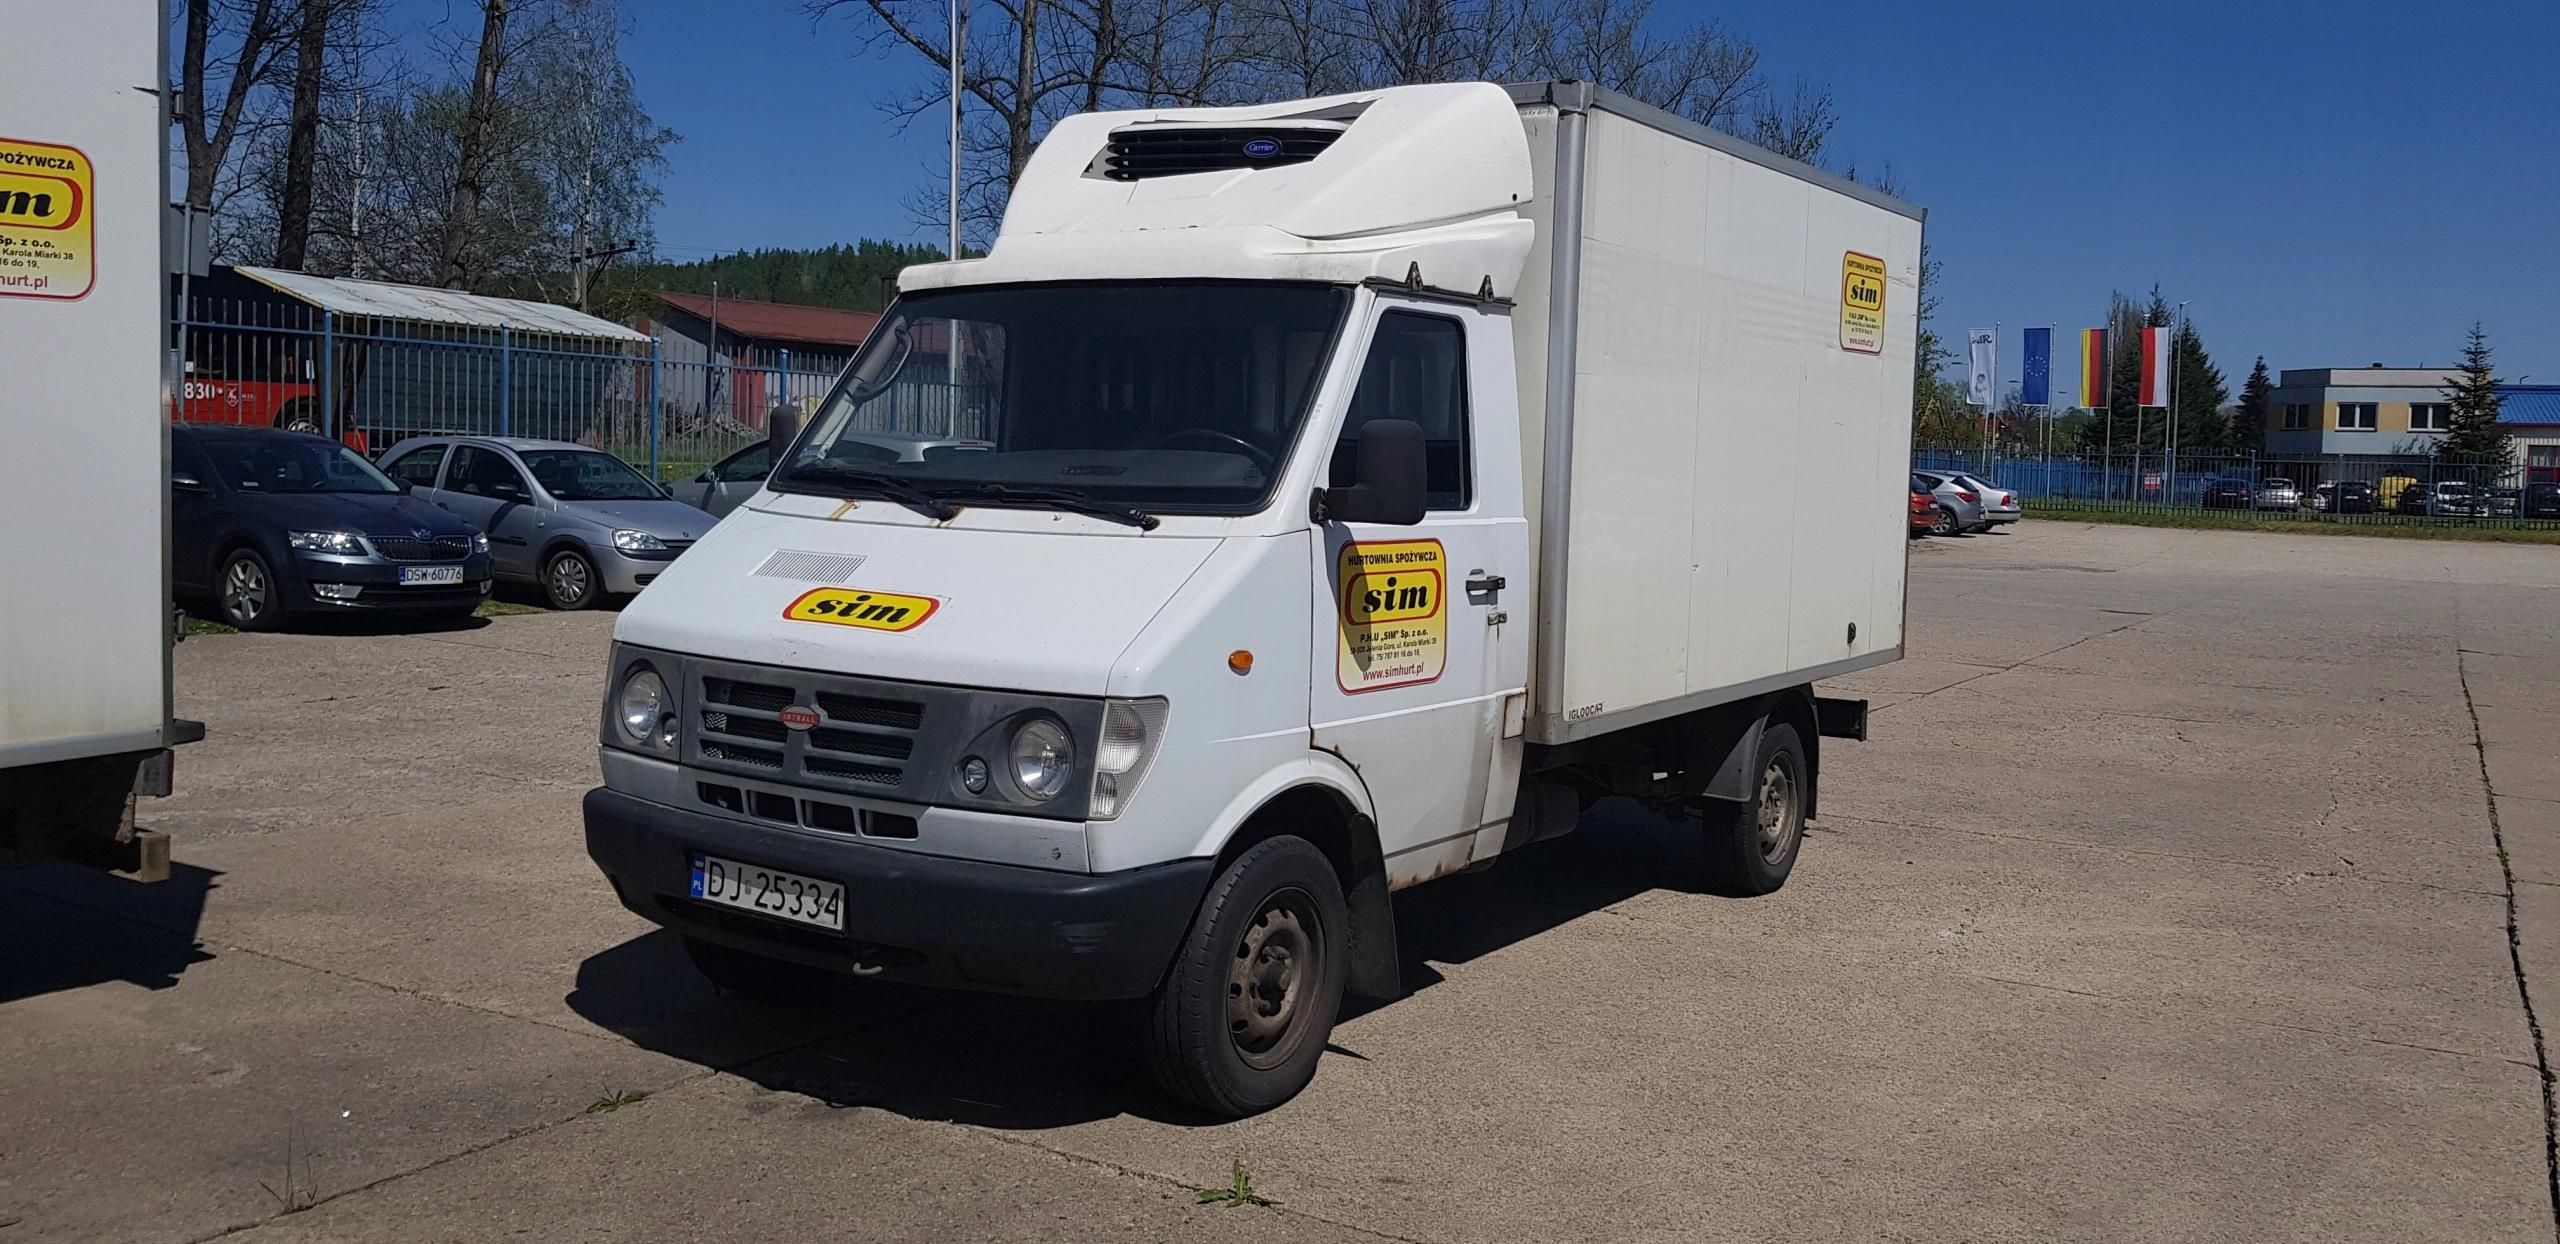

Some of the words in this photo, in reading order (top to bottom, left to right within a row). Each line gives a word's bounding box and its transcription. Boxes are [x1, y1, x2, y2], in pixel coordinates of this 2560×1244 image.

[1249, 143, 1274, 152] Carrier
[31, 240, 55, 248] o.o.
[2, 248, 32, 257] Karola
[34, 250, 61, 259] Miarki
[11, 259, 24, 267] do
[1850, 278, 1877, 304] sim
[1348, 553, 1394, 566] HURTOWNIA
[1395, 550, 1438, 563] SPOŻYWCZA
[406, 569, 428, 581] DSW
[431, 568, 462, 581] 60776
[1362, 576, 1429, 614] sim
[808, 594, 911, 624] sim
[1360, 632, 1379, 643] P.H.U
[1363, 661, 1424, 681] www.simhurt.pl
[1568, 702, 1603, 720] IGLOOCAR
[707, 860, 742, 901] DJ
[754, 872, 840, 925] 25334
